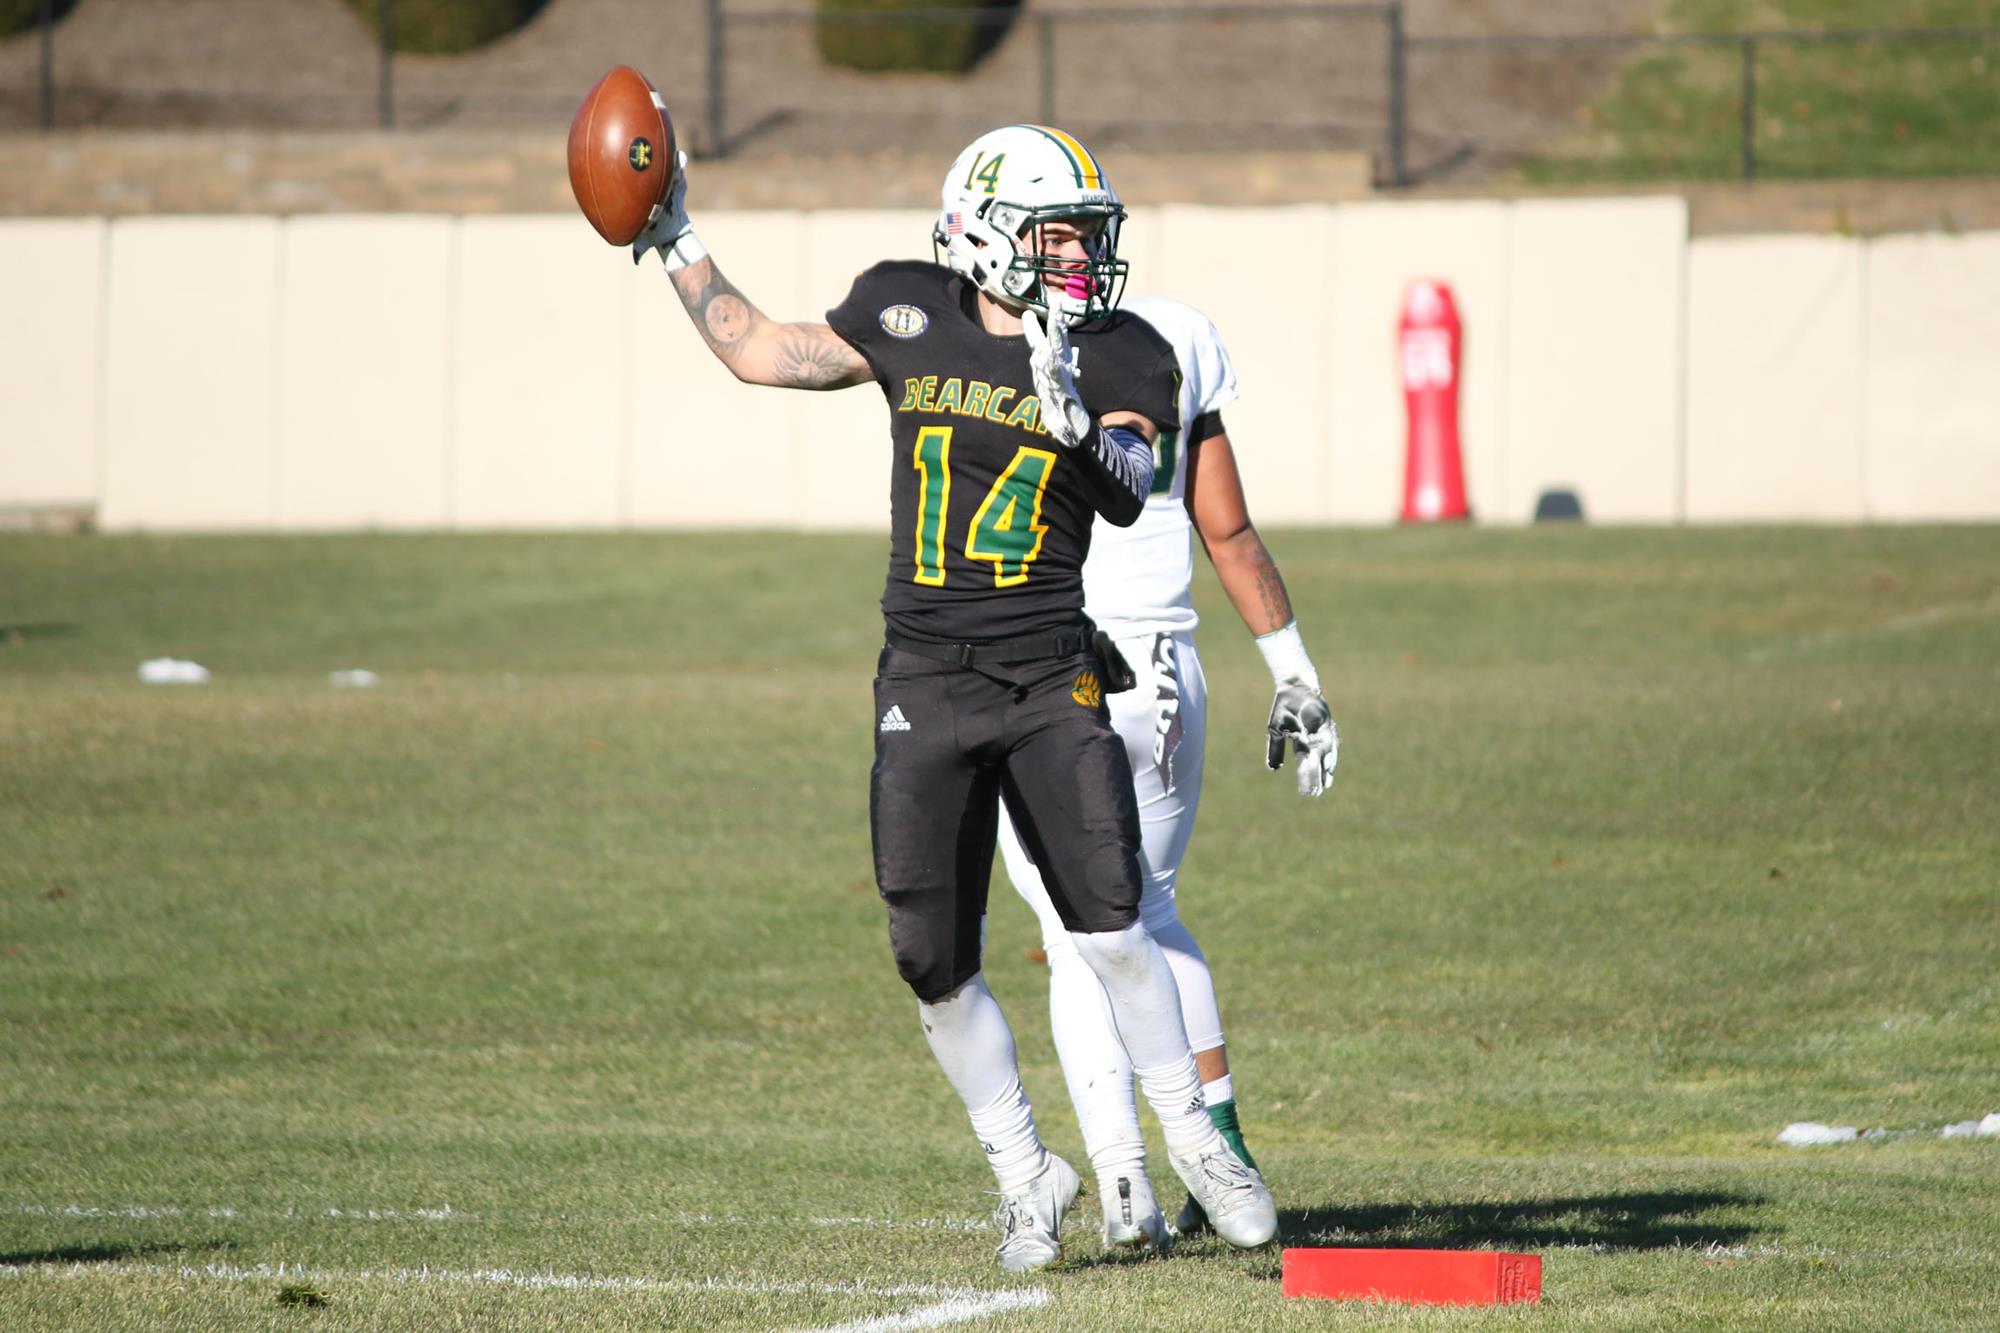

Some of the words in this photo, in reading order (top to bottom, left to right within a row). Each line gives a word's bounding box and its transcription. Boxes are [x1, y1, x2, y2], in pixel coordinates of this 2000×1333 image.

[963, 150, 1006, 194] 14
[899, 375, 1054, 436] BEARCA
[913, 426, 1057, 588] 14
